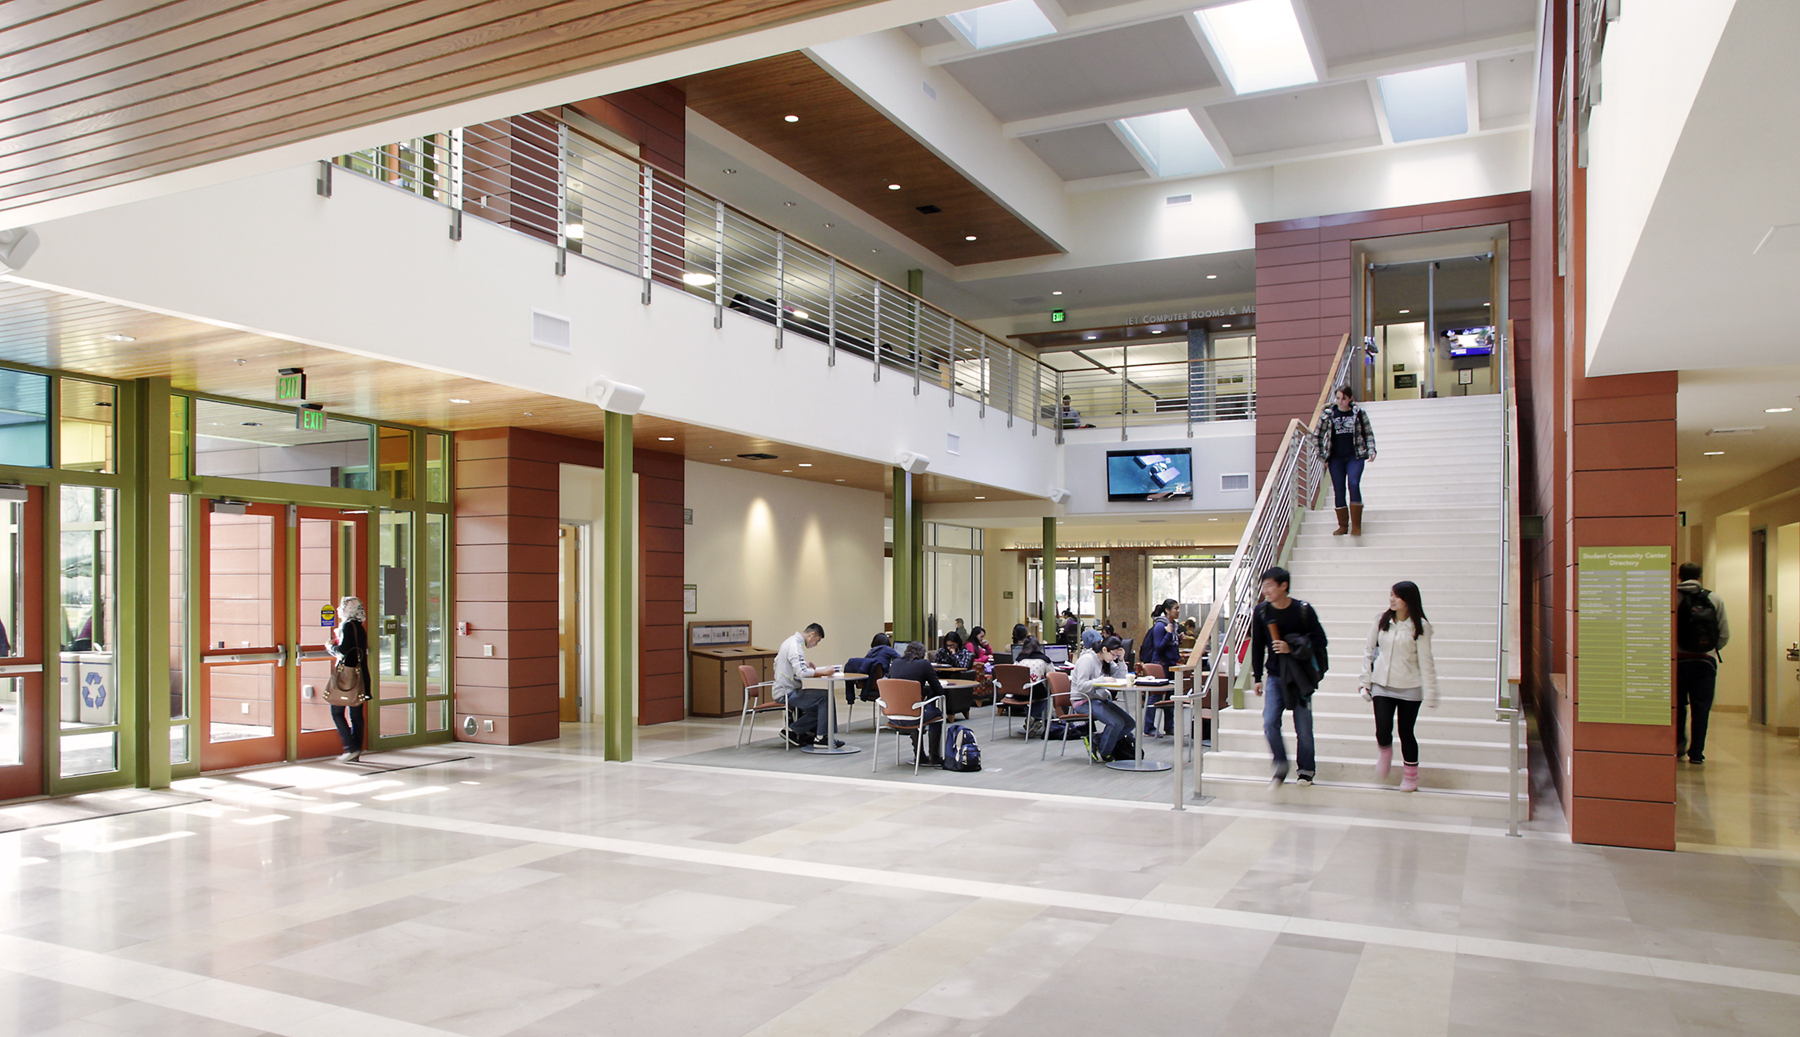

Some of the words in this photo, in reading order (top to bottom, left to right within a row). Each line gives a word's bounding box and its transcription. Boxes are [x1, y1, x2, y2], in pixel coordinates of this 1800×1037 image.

[1142, 313, 1188, 324] COMPUTER
[1191, 309, 1225, 319] ROOMS
[1228, 306, 1237, 316] &
[1242, 305, 1256, 314] ME
[279, 376, 299, 399] EXIT
[303, 410, 324, 430] EXIT
[1014, 540, 1043, 550] STUDEN
[1056, 540, 1102, 549] ECRUITMENT
[1105, 539, 1112, 548] &
[1117, 539, 1161, 547] RETENTION
[1164, 538, 1196, 547] CENTER
[1608, 552, 1644, 560] Community
